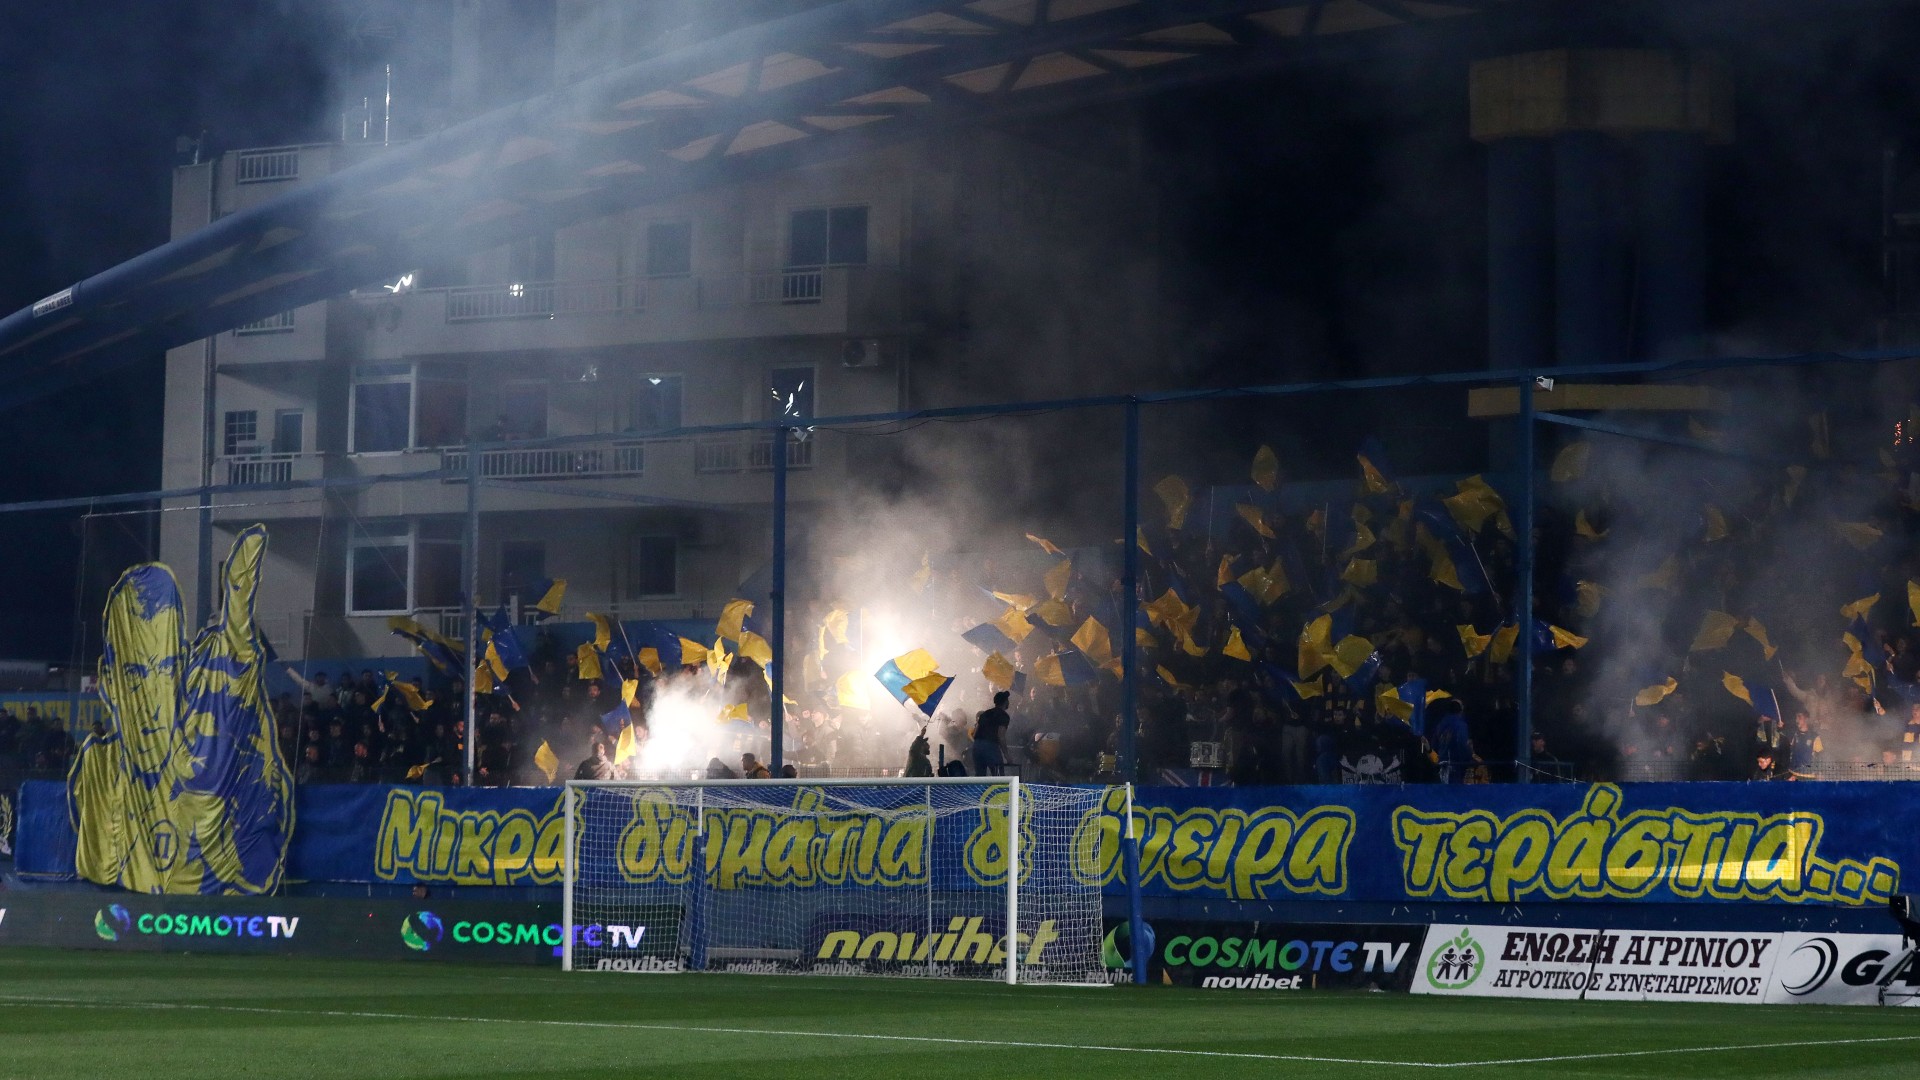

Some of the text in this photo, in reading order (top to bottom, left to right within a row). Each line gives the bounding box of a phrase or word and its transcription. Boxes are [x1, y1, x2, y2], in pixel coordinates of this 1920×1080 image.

[375, 788, 586, 886] Μικρά
[137, 913, 299, 938] COSMOTE TV
[452, 920, 646, 949] COSMOTE TV
[596, 955, 687, 972] novibet
[1164, 935, 1411, 974] COSMOTE TV
[1500, 932, 1771, 968] ΕΝΩΣΗ ΑΓΡΙΝΙΟΥ
[901, 962, 956, 978] novbet
[1202, 973, 1303, 990] novibet
[1493, 969, 1761, 996] ΑΓΡΟΤΙΚΟΣ ΣΥΝΕΤΑΙΡΙΣΜΟΣ
